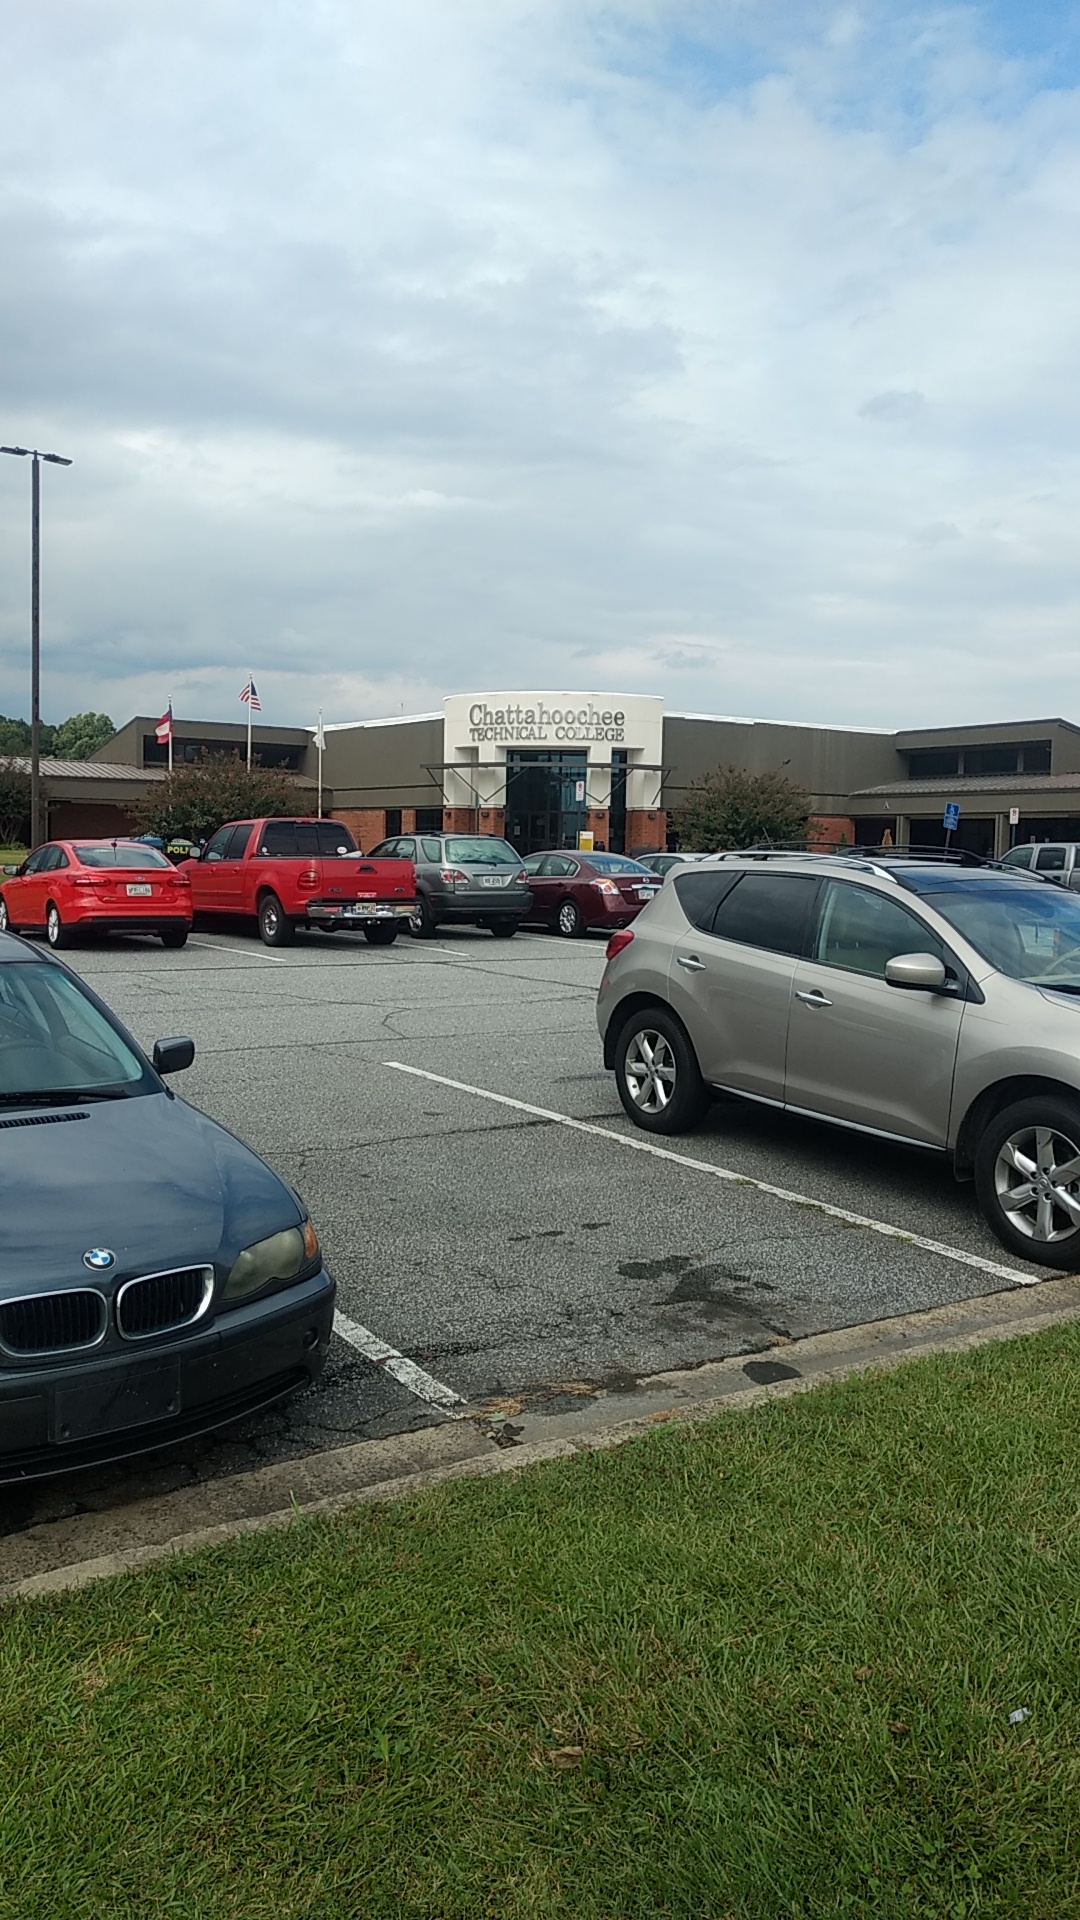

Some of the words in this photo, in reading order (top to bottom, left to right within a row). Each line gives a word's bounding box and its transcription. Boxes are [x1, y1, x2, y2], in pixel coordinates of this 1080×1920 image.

[469, 702, 625, 726] Chattahoochee
[469, 726, 547, 742] TECHNICAL
[555, 726, 624, 741] COLLEGE
[883, 801, 890, 810] A
